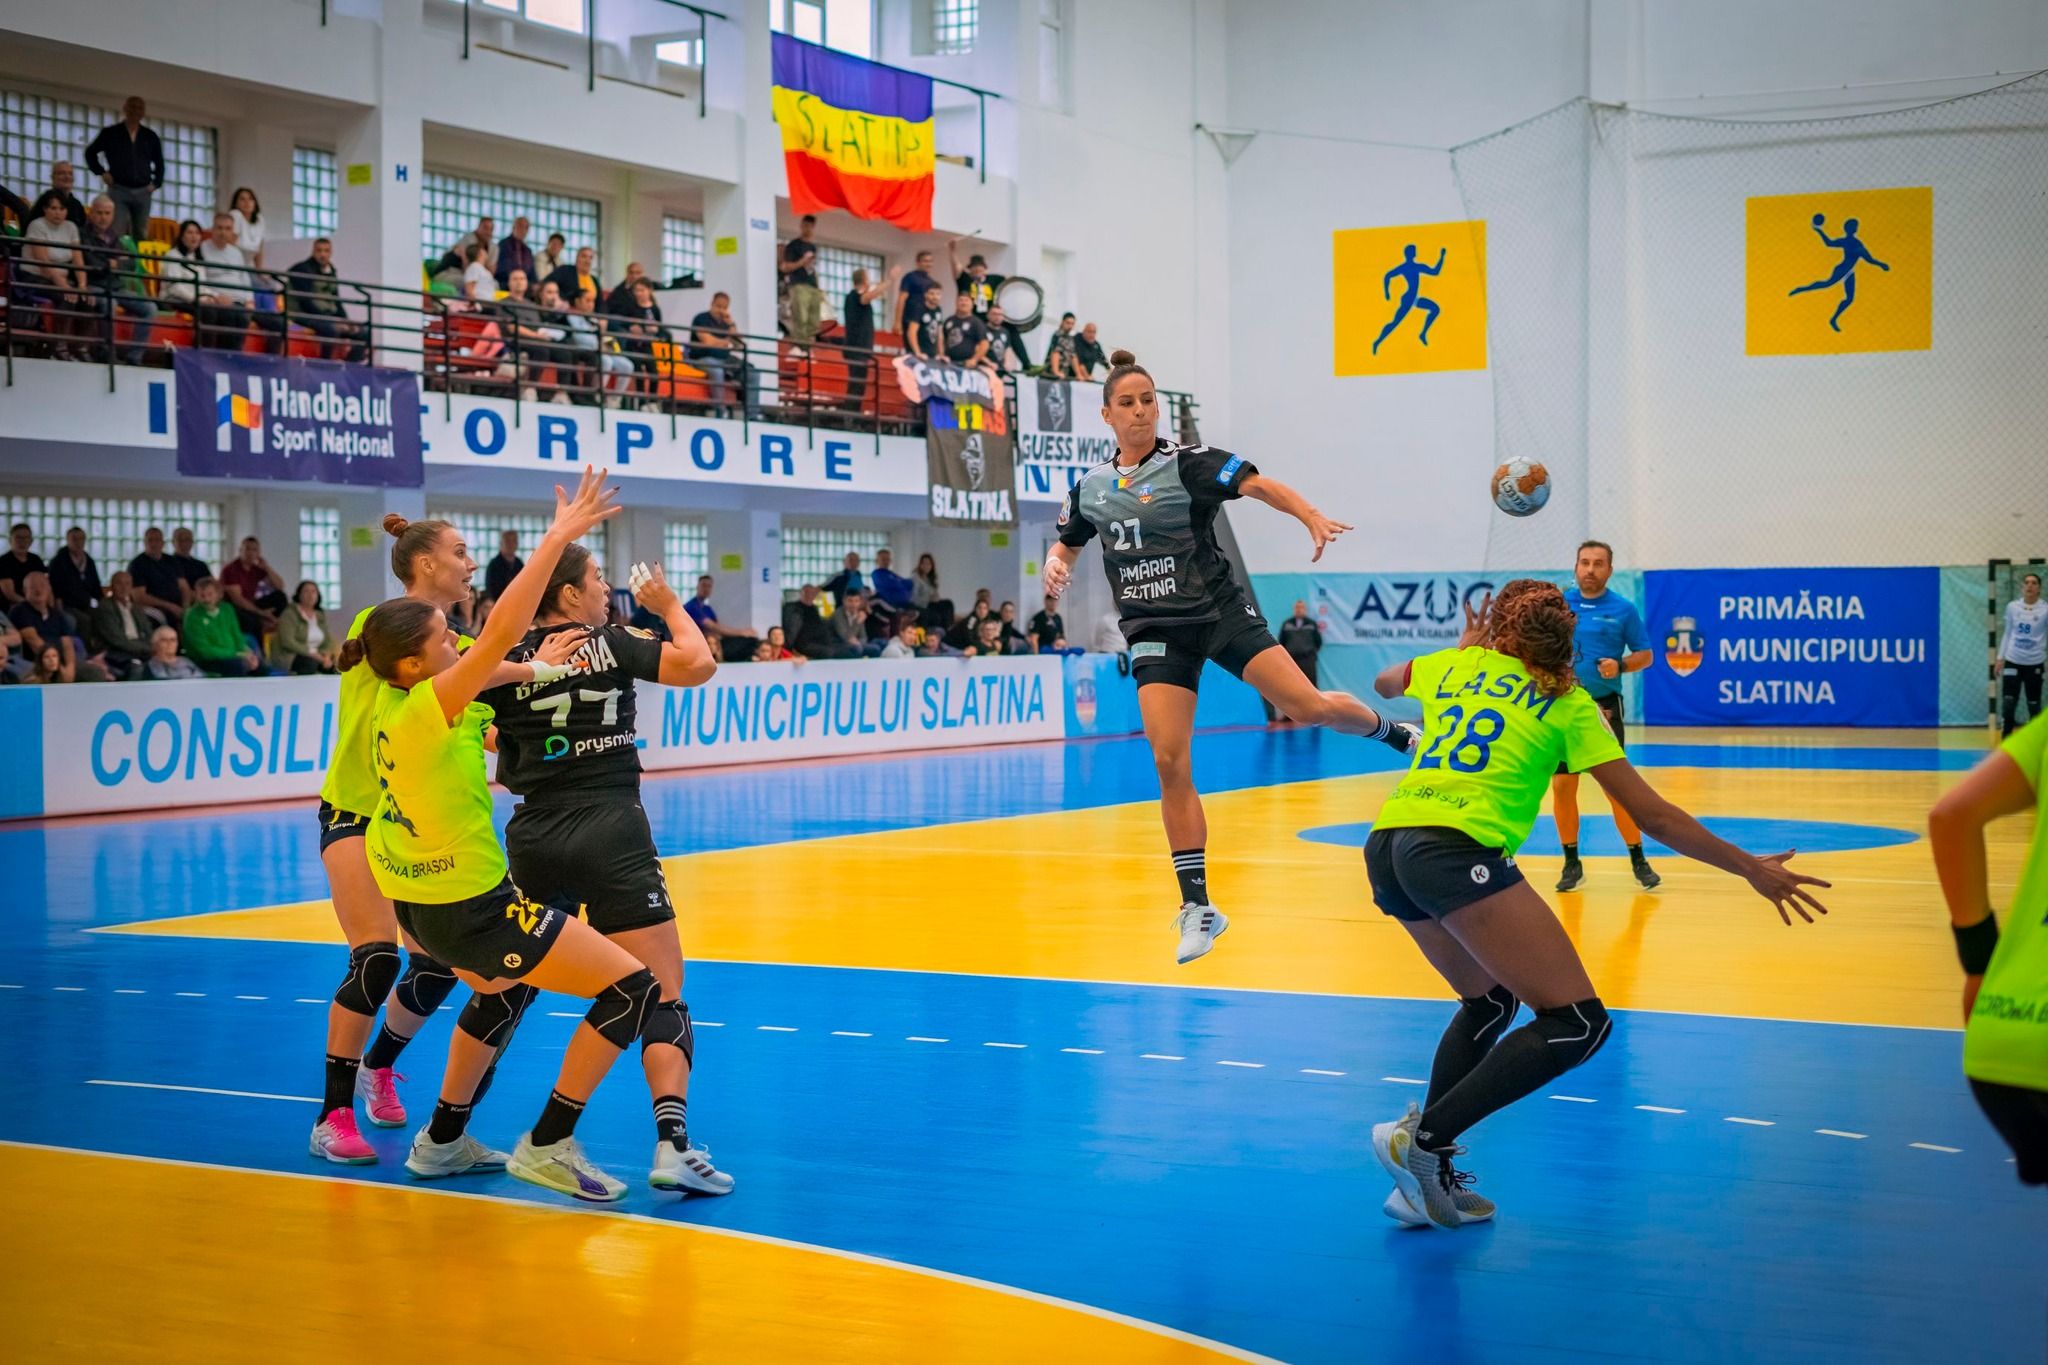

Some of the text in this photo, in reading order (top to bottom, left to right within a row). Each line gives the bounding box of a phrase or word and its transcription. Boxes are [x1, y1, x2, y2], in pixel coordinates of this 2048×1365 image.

[396, 164, 408, 182] H
[271, 377, 393, 427] Handbalul
[420, 404, 853, 482] ORPORE
[1023, 433, 1073, 462] GUESS
[932, 484, 1013, 522] SLATINA
[1110, 517, 1144, 551] 27
[1719, 589, 1865, 620] PRIMĂRIA
[1719, 638, 1925, 663] MUNICIPIULUI
[530, 687, 623, 728] 77
[1718, 680, 1836, 705] SLATINA
[91, 702, 333, 787] CONSILI
[661, 679, 912, 748] MUNICIPIULUI
[921, 673, 1045, 730] SLATINA
[1416, 704, 1506, 773] 28
[533, 909, 554, 938] Kempa
